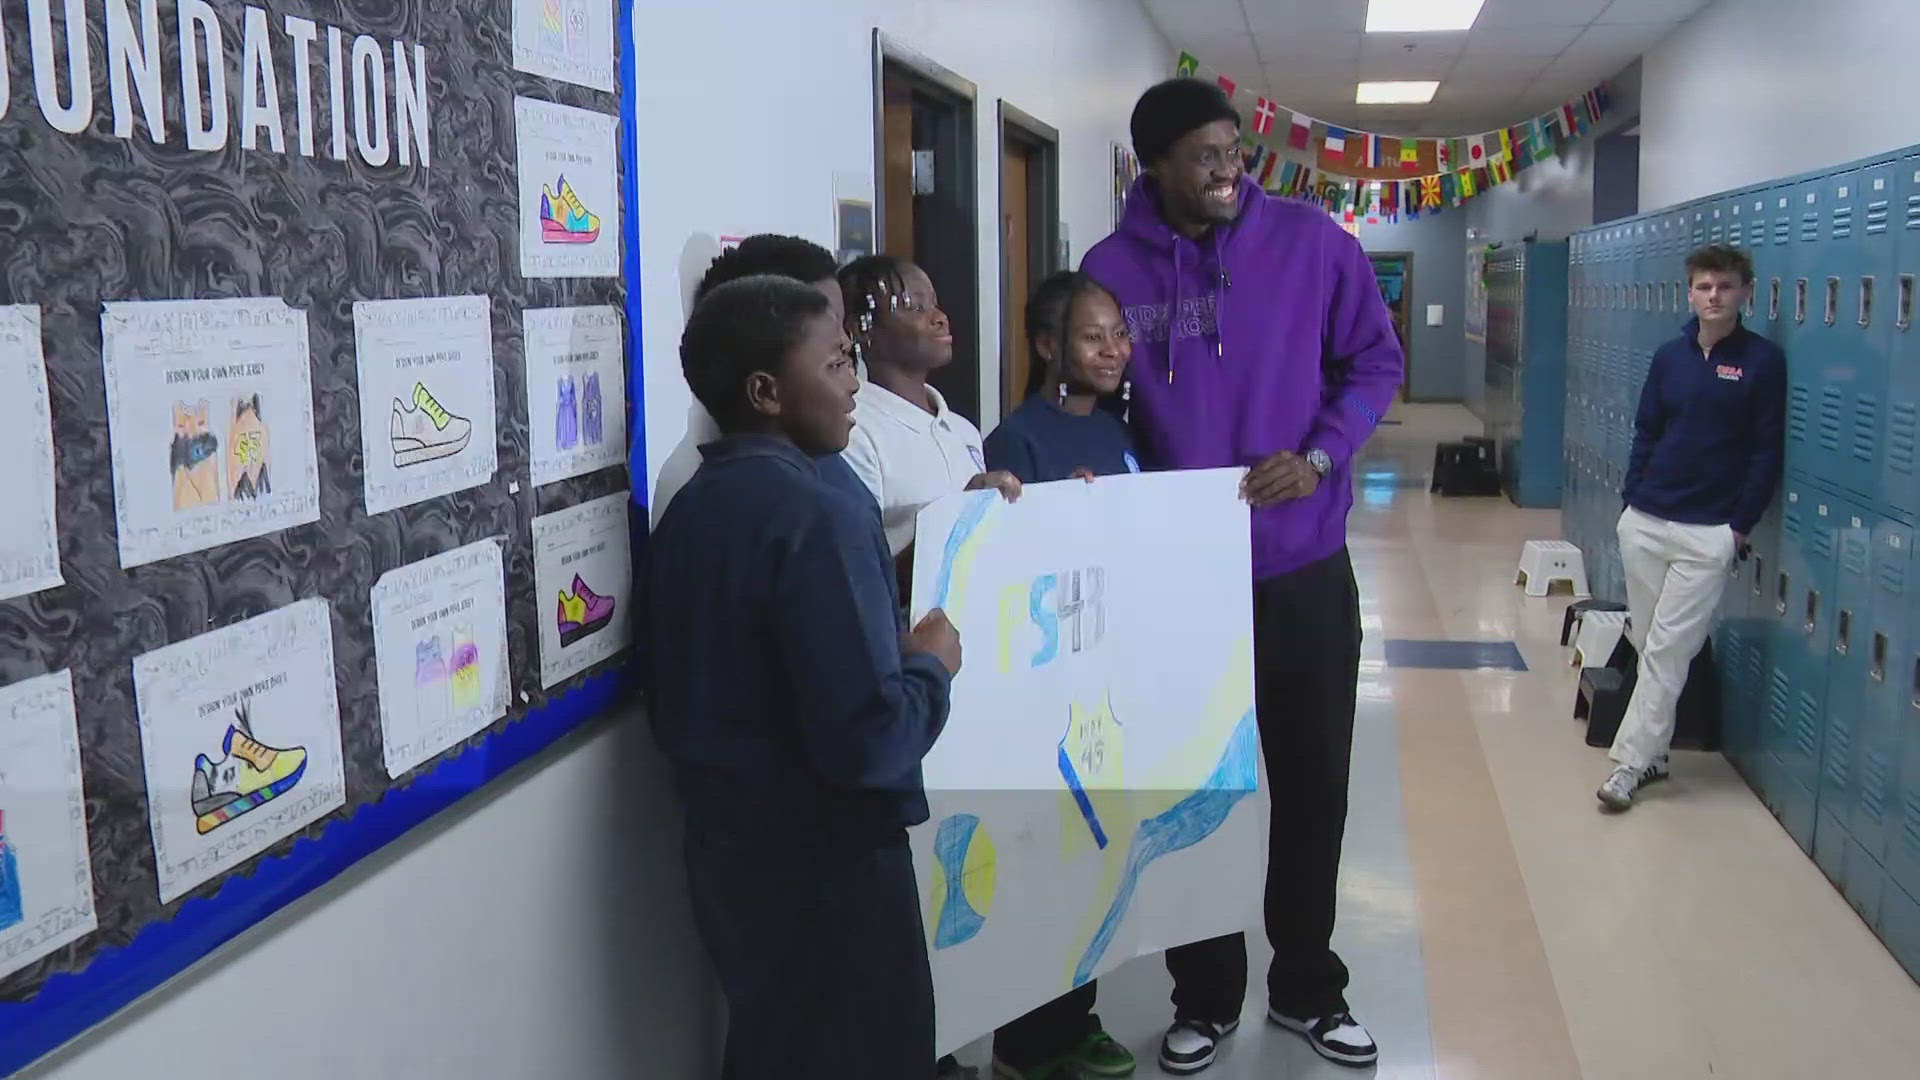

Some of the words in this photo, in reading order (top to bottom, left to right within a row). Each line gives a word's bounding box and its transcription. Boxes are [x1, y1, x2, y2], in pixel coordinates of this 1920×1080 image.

[166, 369, 190, 384] DESIGN
[191, 367, 210, 381] YOUR
[211, 366, 228, 379] OWN
[997, 567, 1105, 673] PS43
